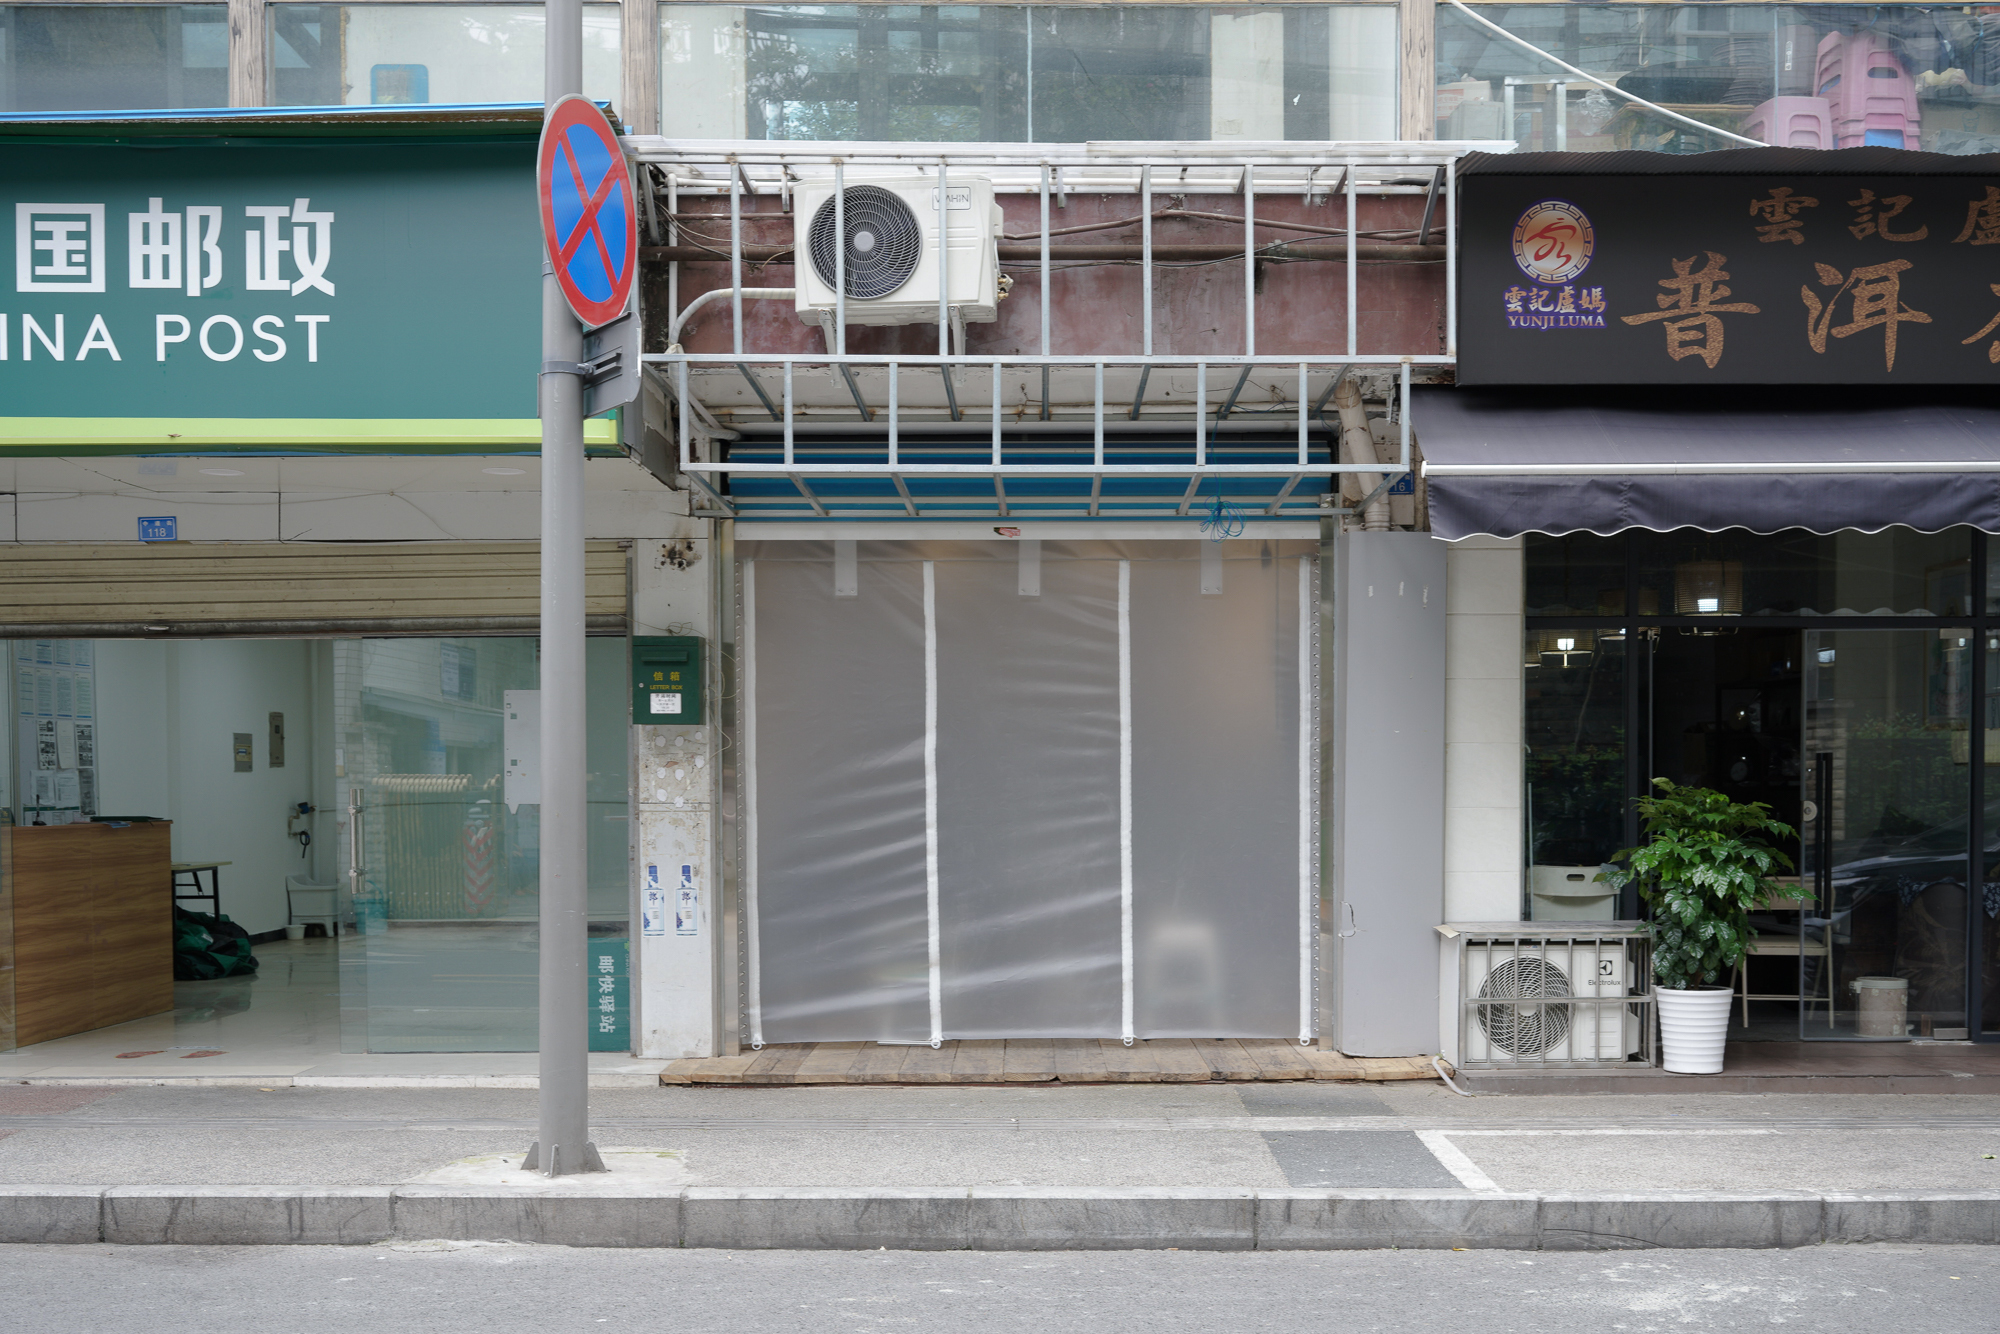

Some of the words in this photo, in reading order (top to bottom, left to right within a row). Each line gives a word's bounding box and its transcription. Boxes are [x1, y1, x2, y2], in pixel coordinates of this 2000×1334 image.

[15, 197, 336, 297] 国邮政
[1504, 286, 1606, 313] 雲記盧媽
[1507, 315, 1555, 329] YUNJI
[1558, 315, 1605, 327] LUMA
[0, 313, 122, 361] INA
[156, 314, 330, 362] POST
[148, 528, 167, 537] 118
[653, 671, 680, 681] 信箱
[598, 955, 616, 1033] 邮快驿站
